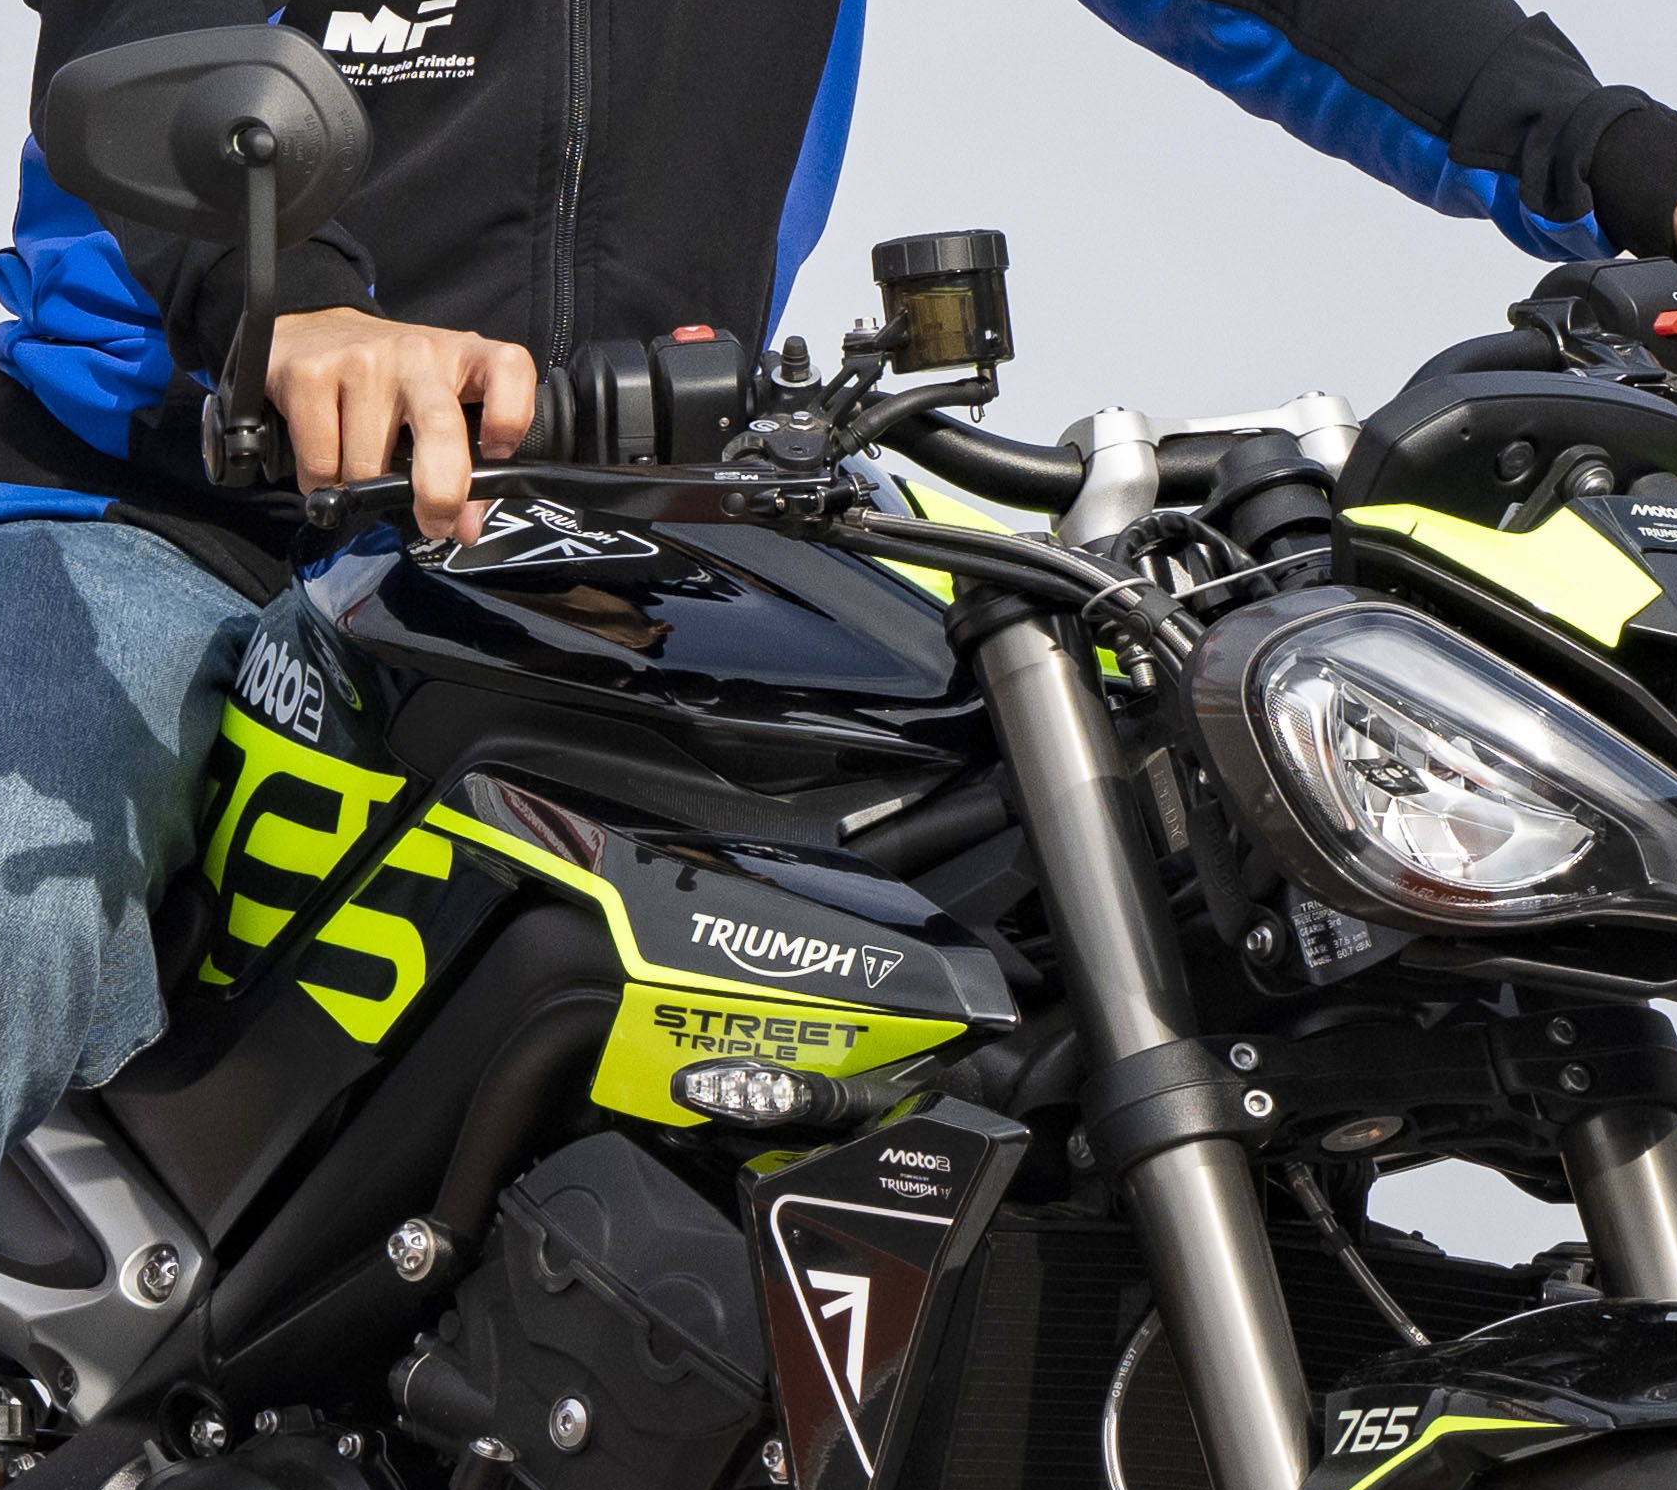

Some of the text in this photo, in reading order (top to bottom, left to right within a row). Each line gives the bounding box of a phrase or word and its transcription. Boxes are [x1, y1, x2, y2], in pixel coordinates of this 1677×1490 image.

[415, 54, 476, 68] Frindes
[381, 69, 475, 85] REFRIGERATION
[690, 913, 857, 977] TRIUMPH
[653, 1004, 869, 1048] STREET
[669, 1031, 799, 1062] TRIPLE
[878, 1148, 951, 1172] Moto2
[878, 1176, 938, 1199] TRIUMPH
[1331, 1406, 1419, 1455] 765
